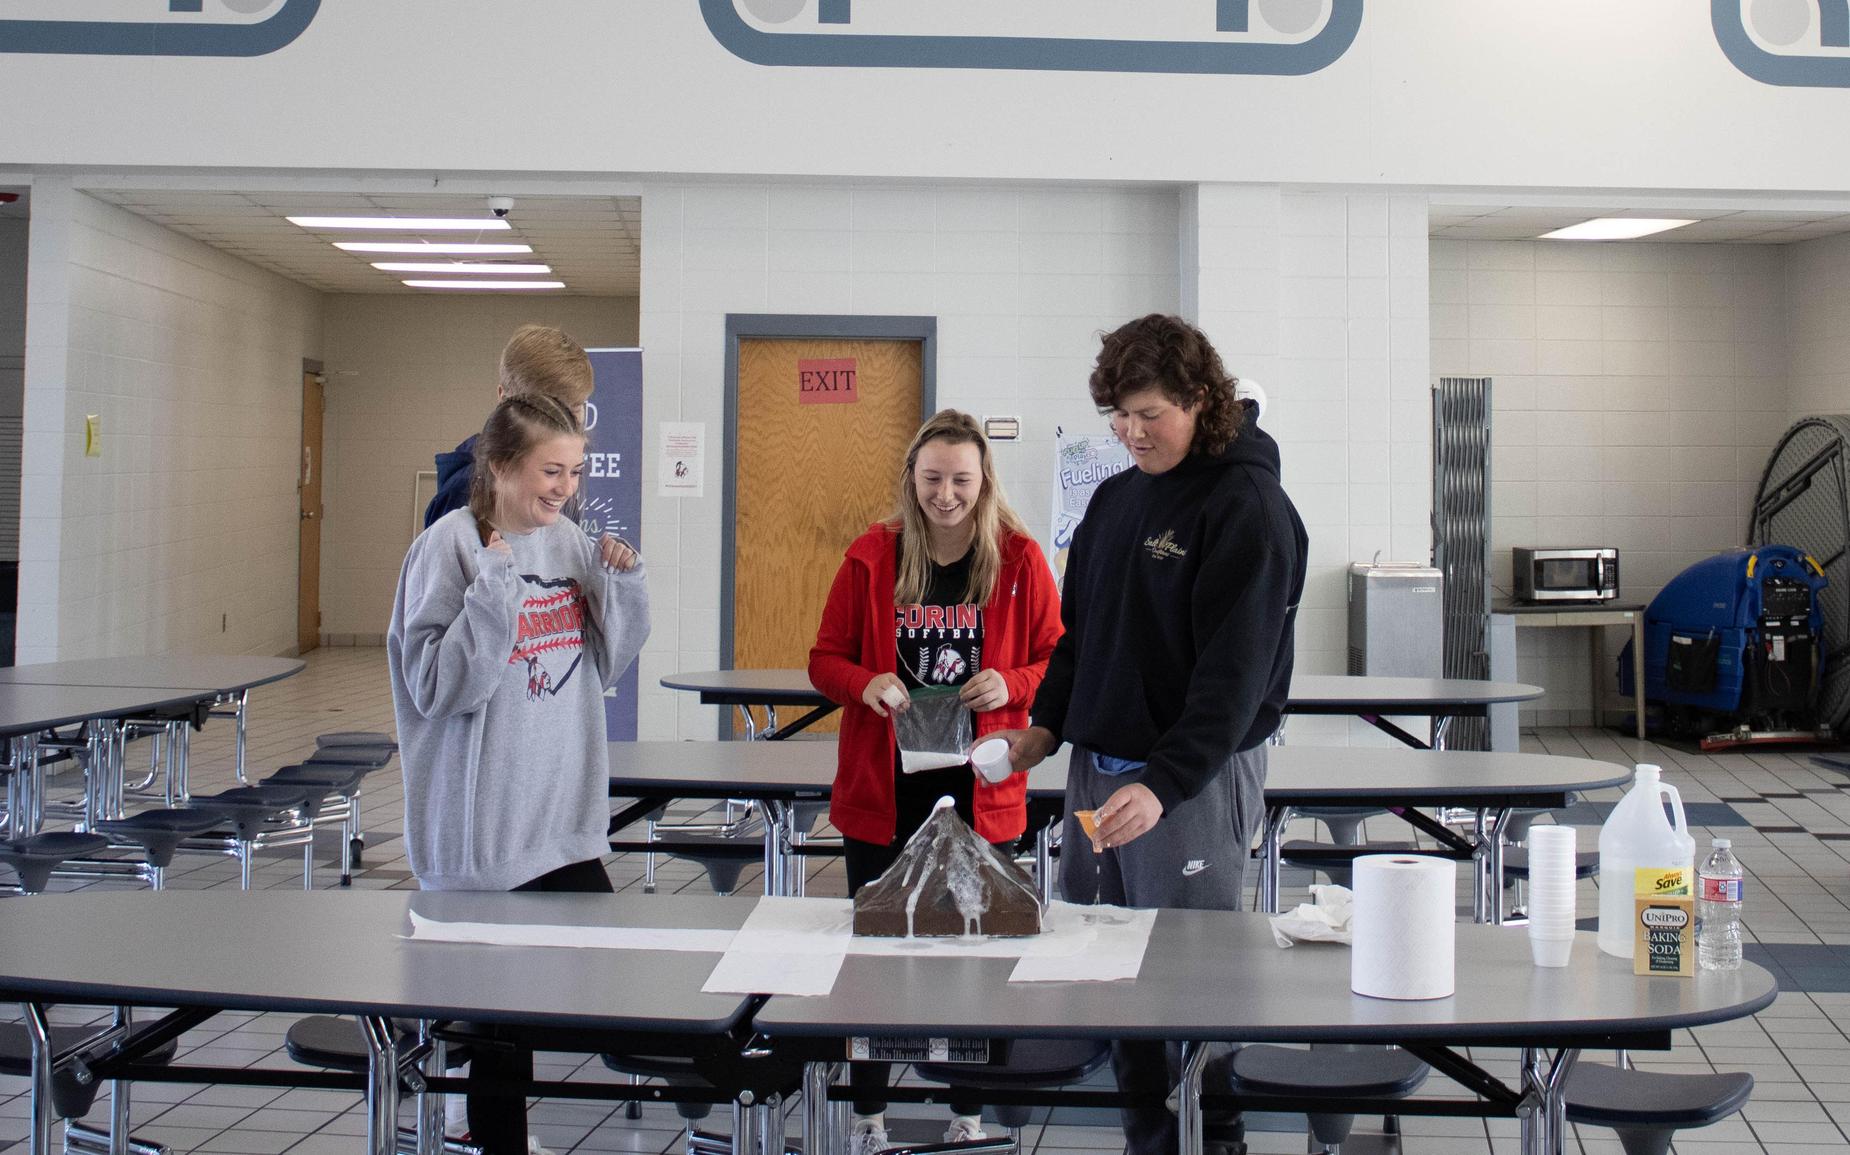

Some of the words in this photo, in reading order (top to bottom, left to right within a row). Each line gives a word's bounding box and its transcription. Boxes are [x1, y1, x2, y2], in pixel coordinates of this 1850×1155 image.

[800, 370, 856, 391] EXIT
[584, 453, 621, 477] EE
[1060, 462, 1123, 489] Fueling
[1186, 859, 1205, 870] NIKE
[1655, 876, 1682, 890] Save
[1643, 930, 1687, 943] BAKING
[1647, 943, 1682, 955] SODA
